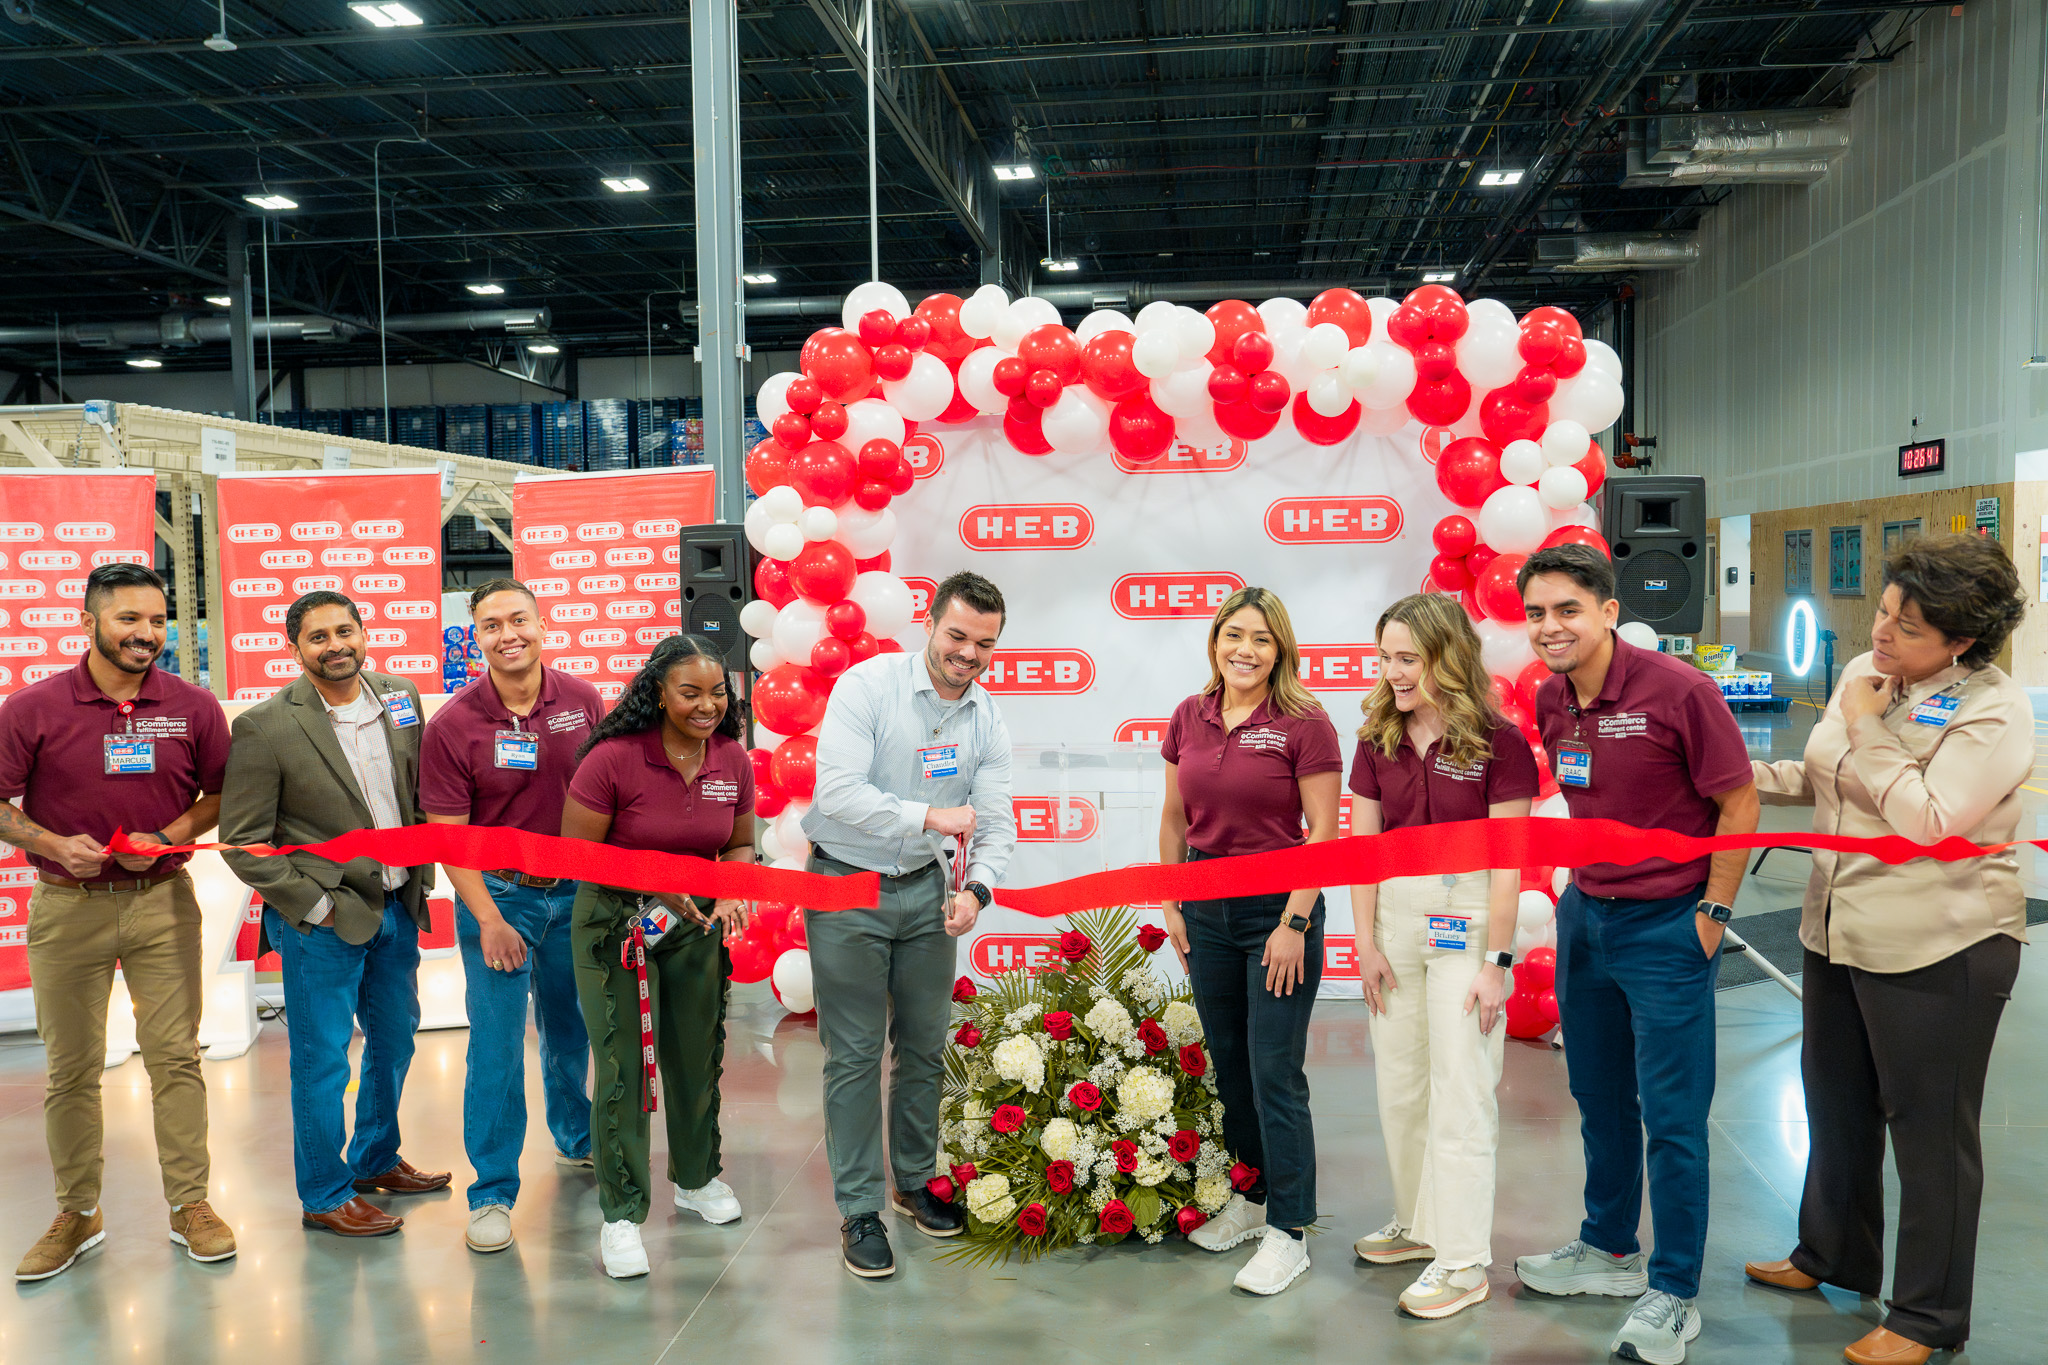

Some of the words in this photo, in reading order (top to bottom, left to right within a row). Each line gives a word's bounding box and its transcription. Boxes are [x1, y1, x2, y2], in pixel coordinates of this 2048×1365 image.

[1168, 438, 1233, 461] E-B
[1283, 507, 1388, 533] H-E-B
[0, 527, 36, 536] -E-B
[976, 515, 1079, 540] H-E-B
[1129, 583, 1233, 608] H-E-B
[1703, 652, 1724, 663] Bounty
[979, 660, 1081, 684] H-E-B
[547, 711, 585, 726] eCommerce
[572, 717, 586, 725] center
[1598, 717, 1647, 727] eCommerce
[1240, 732, 1287, 743] eCommerce
[1266, 739, 1286, 748] center
[112, 756, 147, 765] MARCUS
[926, 760, 956, 770] Chandler
[1562, 767, 1582, 777] ISAAC
[701, 783, 738, 791] eCommerce
